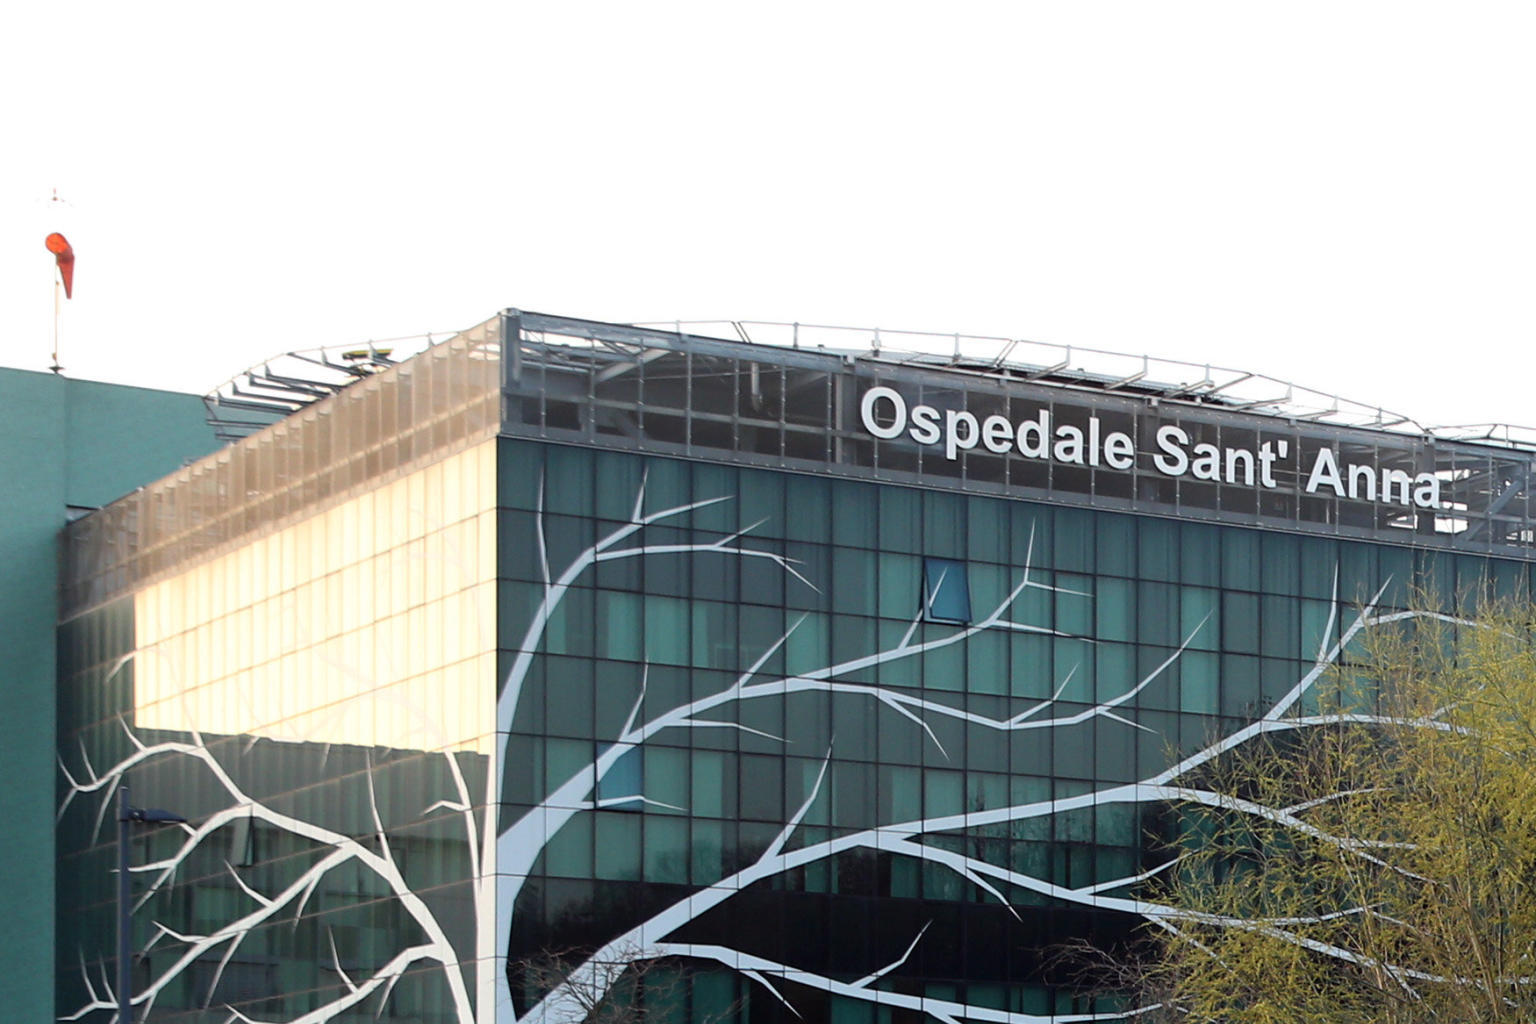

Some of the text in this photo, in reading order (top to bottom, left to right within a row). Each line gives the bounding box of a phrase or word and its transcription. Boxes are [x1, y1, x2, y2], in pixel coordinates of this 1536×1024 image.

[860, 385, 1440, 509] Ospedale Sant' Anna
